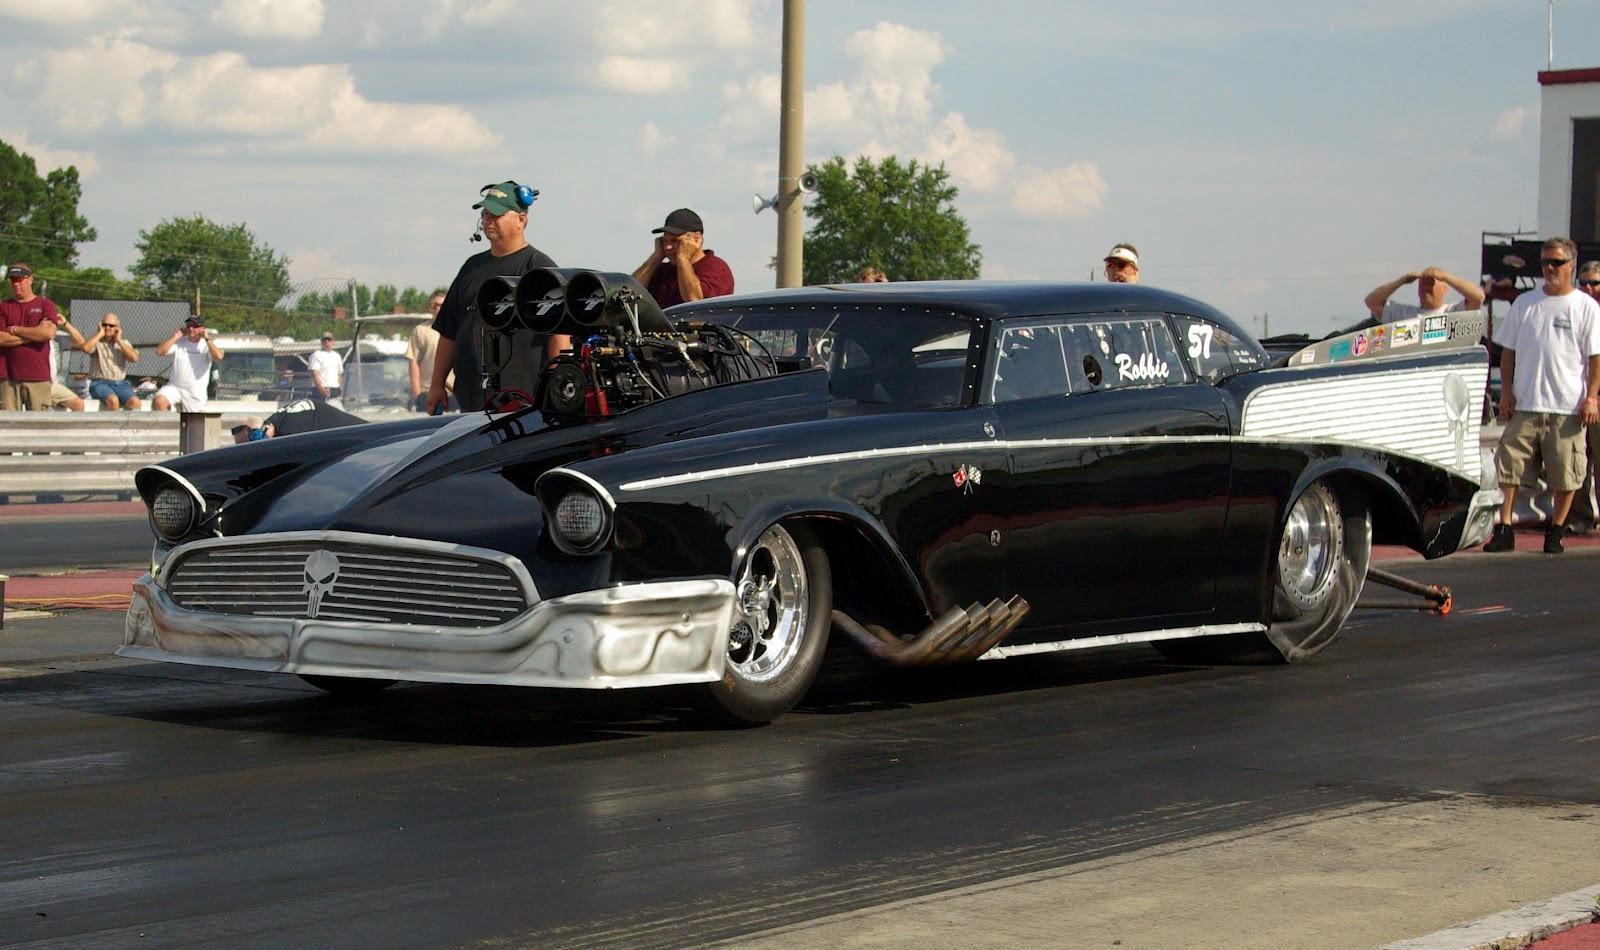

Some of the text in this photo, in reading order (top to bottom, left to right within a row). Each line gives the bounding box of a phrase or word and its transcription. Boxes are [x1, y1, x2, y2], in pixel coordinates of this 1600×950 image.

[1187, 324, 1214, 360] 57
[1447, 318, 1483, 340] Hoosier
[1354, 333, 1365, 355] VP
[1115, 352, 1170, 382] Robbie
